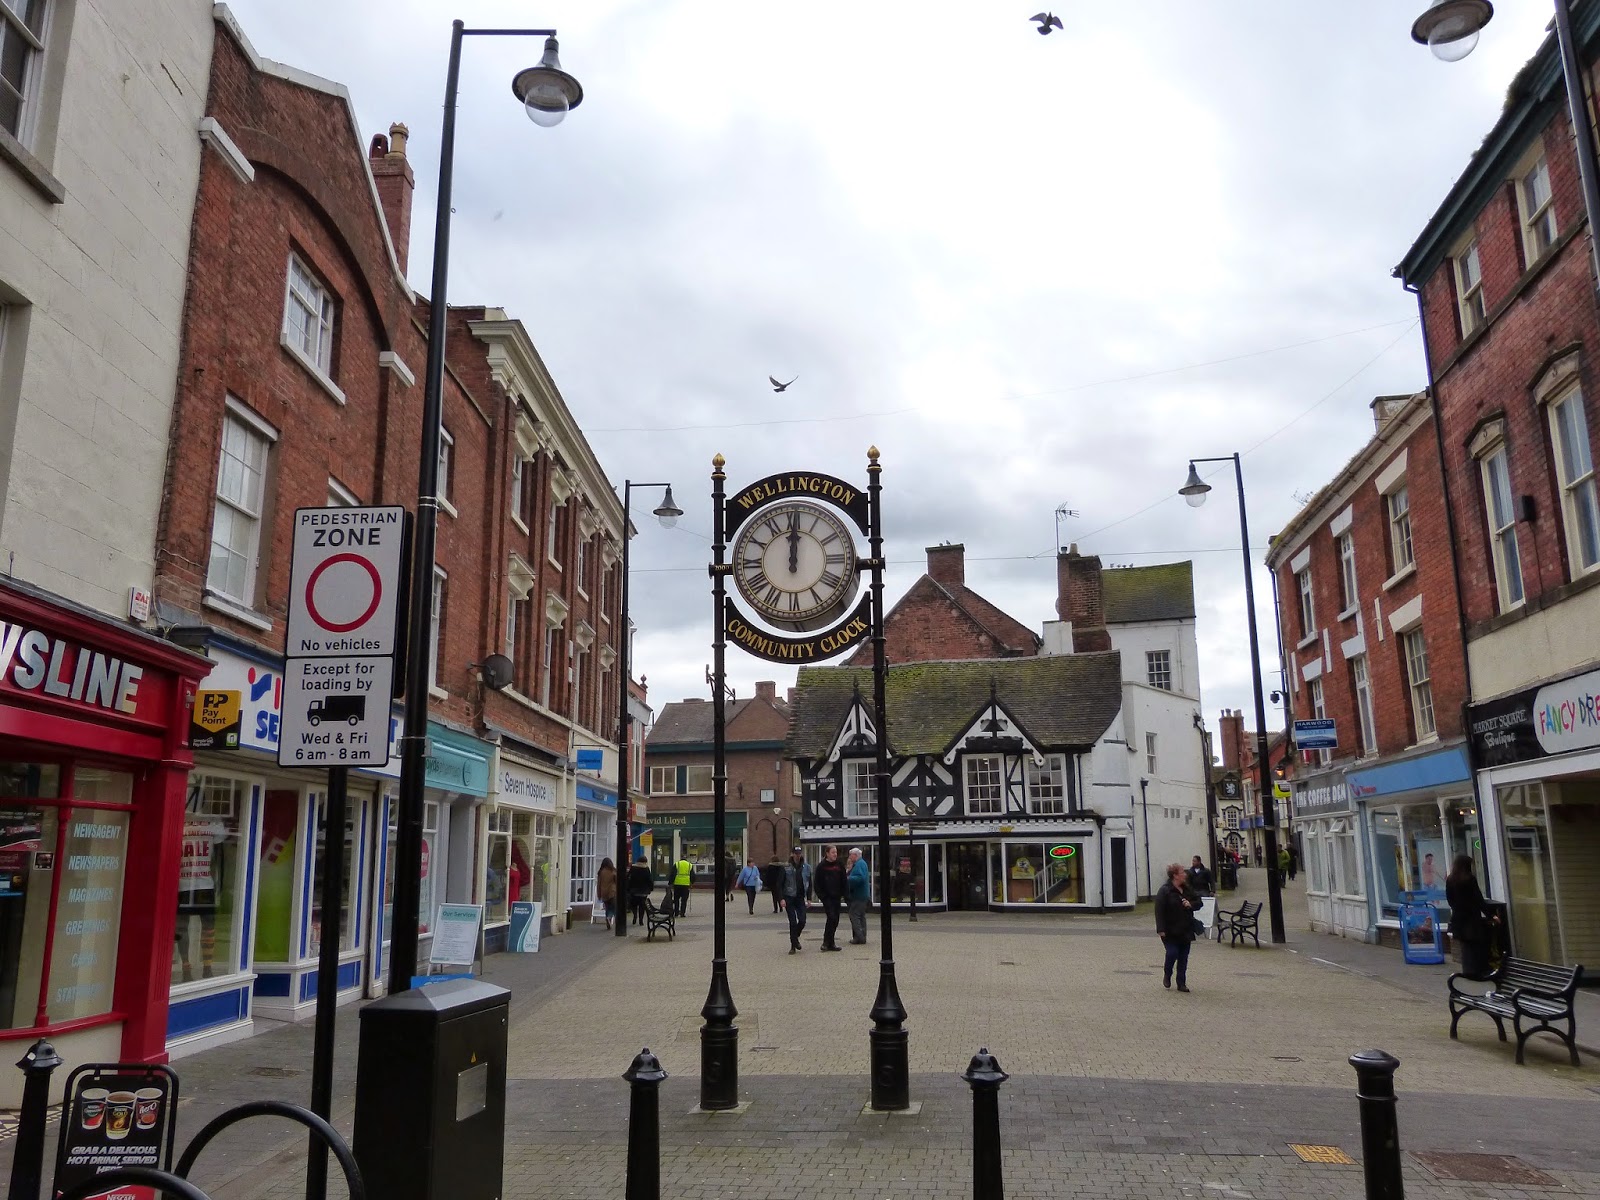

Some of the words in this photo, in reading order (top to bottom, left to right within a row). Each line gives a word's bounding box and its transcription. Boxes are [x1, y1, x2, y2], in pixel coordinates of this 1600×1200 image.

[737, 476, 856, 510] WELLINGTON
[301, 512, 398, 526] PEDESTRIAN
[312, 528, 381, 547] ZONE
[727, 619, 815, 658] COMMUNITY
[820, 615, 868, 653] CLOCK
[301, 639, 320, 651] No
[325, 638, 380, 651] vehicles
[303, 663, 350, 678] Except
[355, 663, 375, 675] for
[302, 678, 351, 692] loading
[356, 678, 373, 692] by
[202, 708, 219, 717] Pay
[1498, 709, 1527, 727] SQUARE
[1539, 699, 1576, 735] FANCY
[201, 717, 227, 725] Point
[301, 732, 330, 744] Wed
[335, 732, 344, 744] &
[350, 732, 368, 744] Fri
[295, 749, 304, 760] 6
[305, 751, 327, 760] am
[339, 749, 347, 760] 8
[349, 750, 371, 760] am
[504, 771, 525, 795] Severn
[525, 778, 546, 802] Hospice
[1295, 791, 1307, 807] THE
[1308, 786, 1331, 806] COFFEE
[664, 816, 687, 826] Lloyd
[73, 823, 122, 839] NEWSAGENT
[1052, 847, 1072, 856] OPEN
[68, 855, 120, 871] NEWSPAPERS
[443, 910, 452, 918] Our
[71, 1146, 99, 1155] GRAB
[98, 1146, 107, 1155] A
[108, 1146, 157, 1155] DELICIOUS
[66, 1156, 90, 1165] HOT
[119, 1156, 158, 1165] SERVED
[96, 1166, 123, 1175] HE
